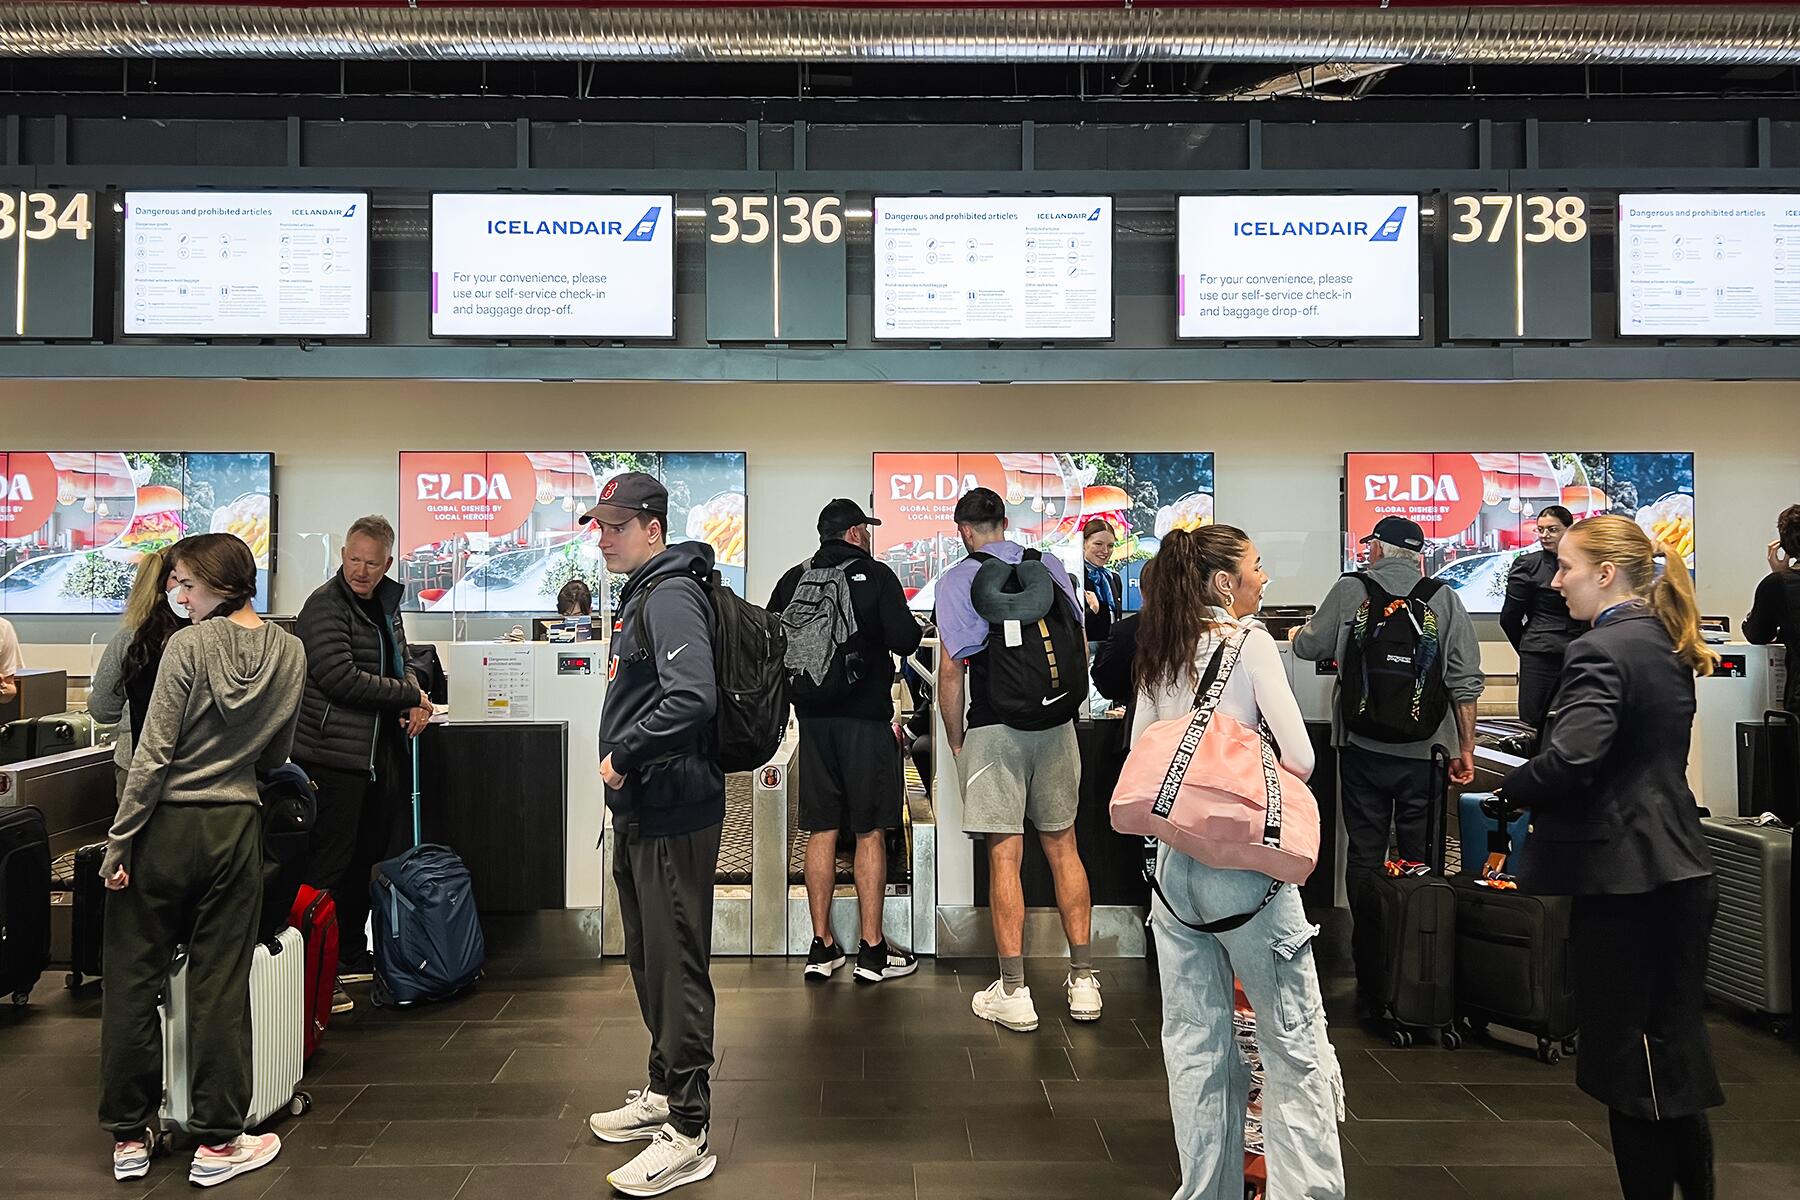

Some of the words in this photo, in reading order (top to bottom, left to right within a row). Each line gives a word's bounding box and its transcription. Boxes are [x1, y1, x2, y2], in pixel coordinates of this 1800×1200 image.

[26, 192, 92, 240] 34
[135, 207, 179, 217] Dangerous
[181, 207, 196, 216] and
[198, 207, 240, 217] prohibited
[242, 207, 272, 216] articles
[885, 212, 928, 223] Dangerous
[929, 212, 944, 221] and
[945, 212, 986, 222] prohibited
[988, 212, 1018, 221] articles
[1452, 196, 1513, 242] 37
[1525, 196, 1587, 242] 38
[1630, 208, 1674, 219] Dangerous
[1676, 208, 1690, 217] and
[1692, 208, 1734, 218] prohibited
[1736, 208, 1766, 217] articles
[711, 196, 770, 243] 35
[782, 196, 842, 243] 36
[488, 220, 622, 236] ICELANDAIR
[1234, 221, 1368, 236] ICELANDAIR
[453, 272, 471, 283] For
[473, 275, 497, 286] your
[499, 272, 570, 285] convenience,
[573, 273, 607, 286] please
[1200, 274, 1218, 284] For
[1220, 276, 1243, 287] your
[1246, 274, 1316, 286] convenience,
[1318, 274, 1353, 287] please
[453, 290, 472, 299] use
[475, 290, 493, 299] our
[495, 288, 557, 299] self-service
[560, 288, 606, 300] check-in
[1200, 292, 1219, 301] use
[1221, 292, 1239, 301] our
[1242, 289, 1304, 301] self-service
[1306, 288, 1352, 300] check-in
[453, 304, 473, 315] and
[476, 304, 523, 318] baggage
[525, 304, 573, 318] drop-off.
[1200, 305, 1220, 317] and
[1223, 305, 1269, 319] baggage
[1272, 305, 1320, 318] drop-off.
[417, 473, 512, 500] ELDA
[890, 474, 980, 500] ELDA
[1365, 474, 1460, 501] ELDA
